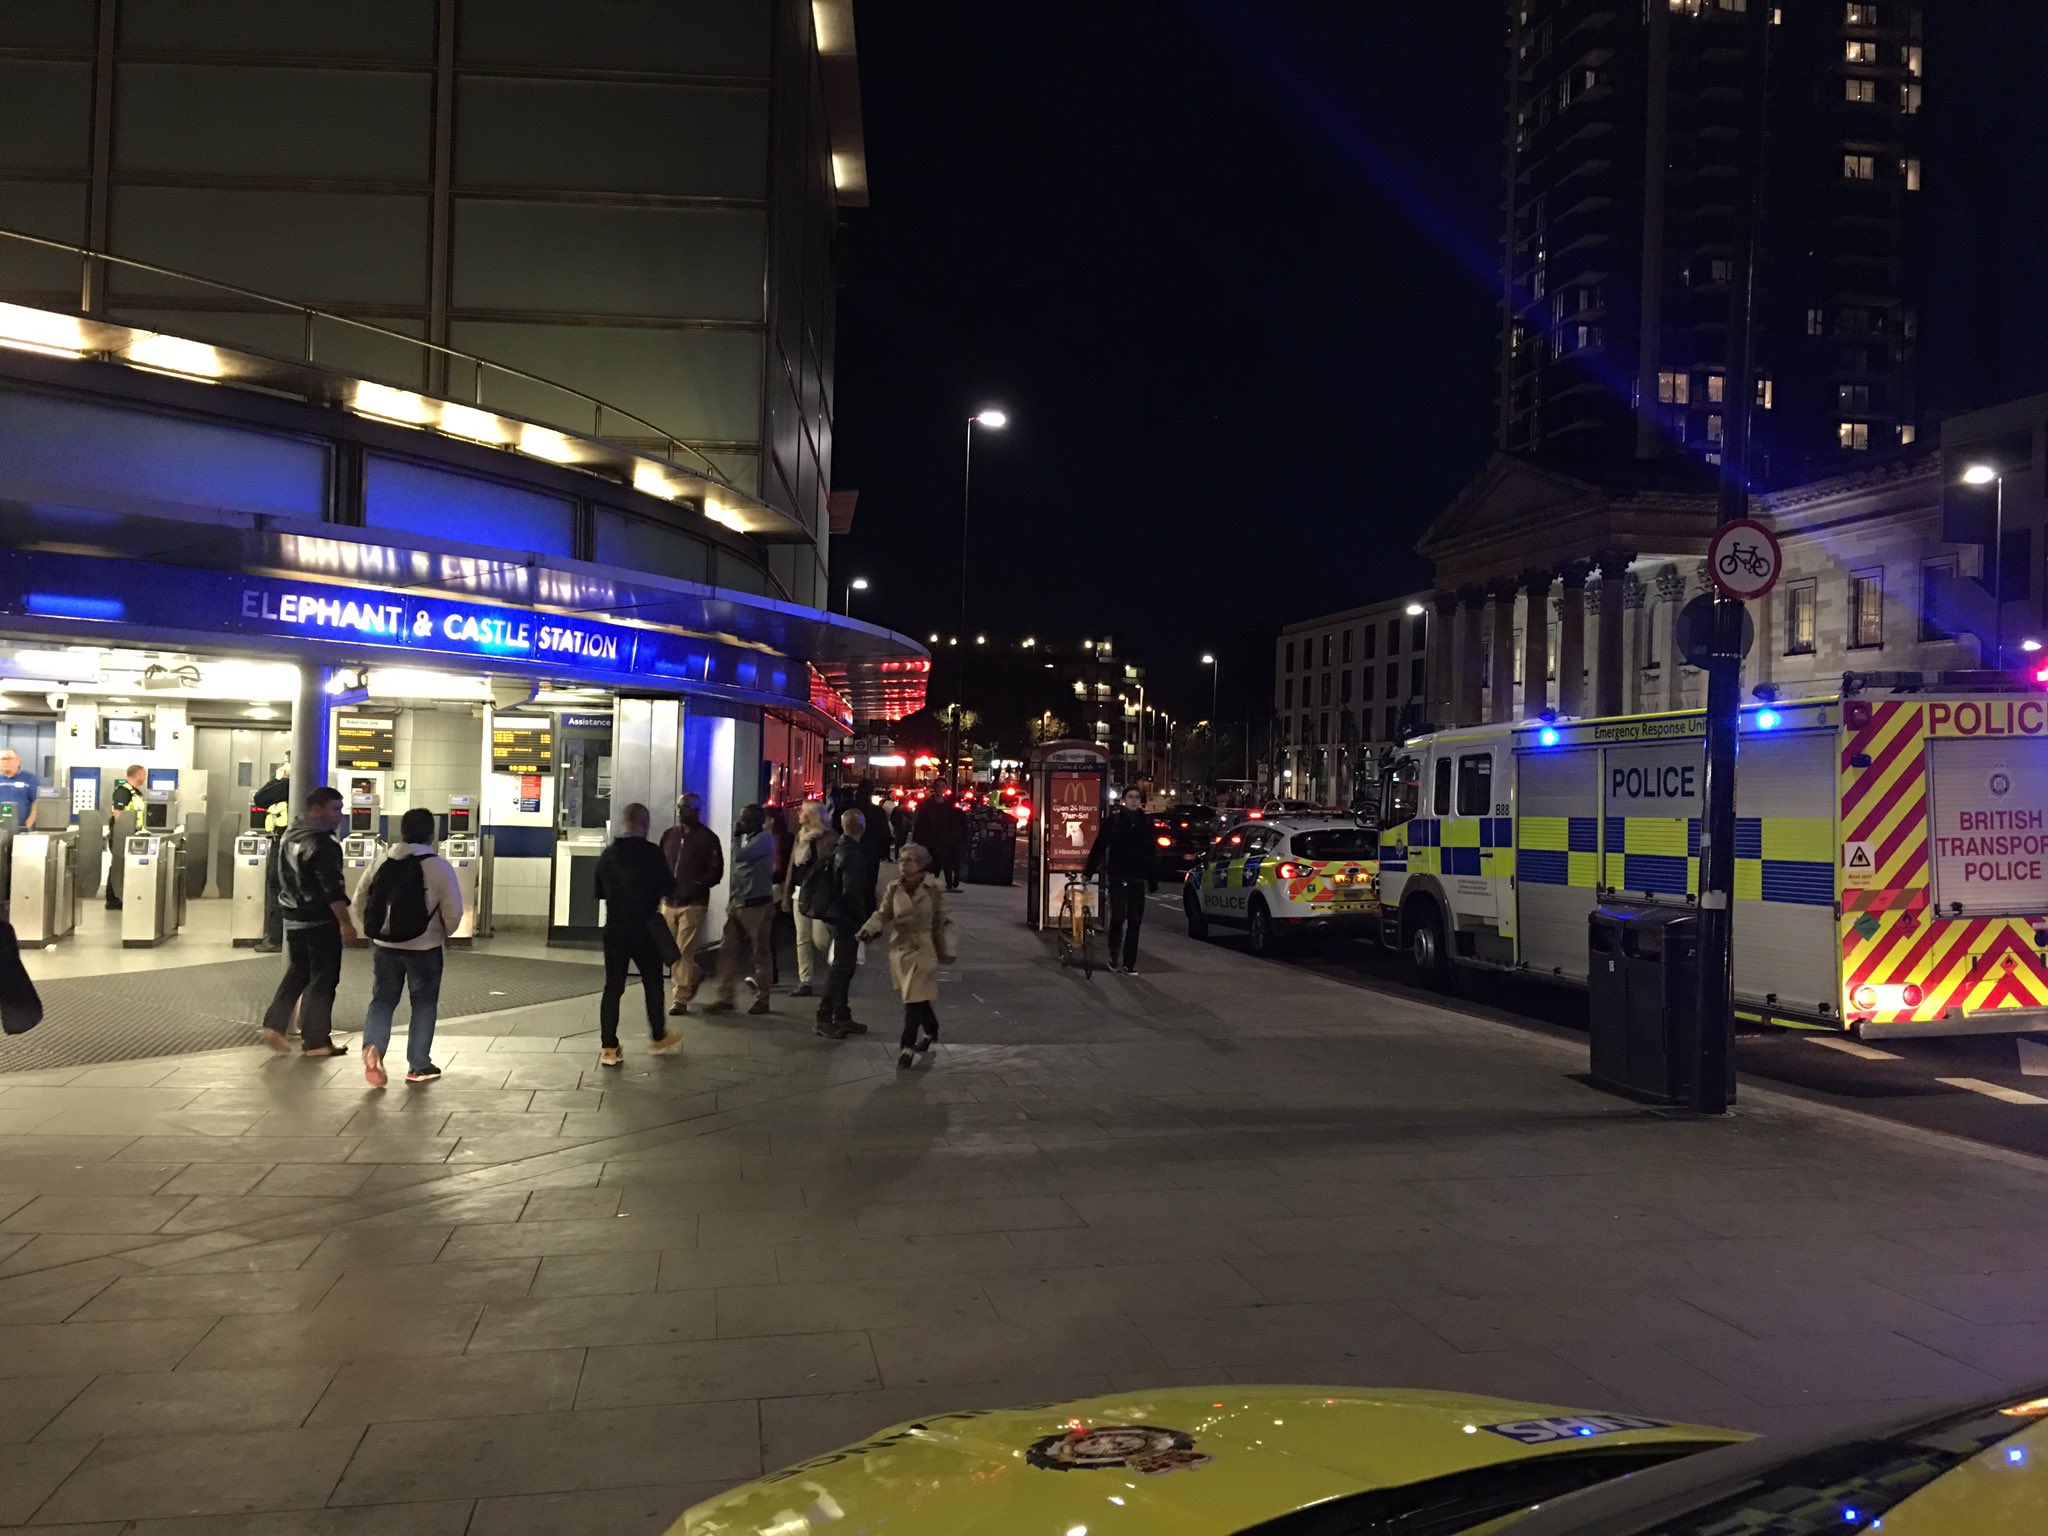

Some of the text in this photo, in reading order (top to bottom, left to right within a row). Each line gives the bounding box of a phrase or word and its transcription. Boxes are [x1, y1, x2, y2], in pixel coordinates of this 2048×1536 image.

[242, 590, 618, 659] ELEPHANT & CASTLE STATION
[568, 717, 611, 726] Assistance
[1929, 701, 2048, 735] POLIC
[1594, 718, 1706, 740] Emergency Response Uni
[1612, 766, 1695, 798] POLICE
[1495, 804, 1510, 816] B88
[1959, 810, 2043, 831] BRITISH
[1937, 835, 2048, 856] TRANSPOR
[1964, 860, 2042, 882] POLICE
[1204, 894, 1246, 910] POLICE
[1310, 903, 1378, 912] POLIC
